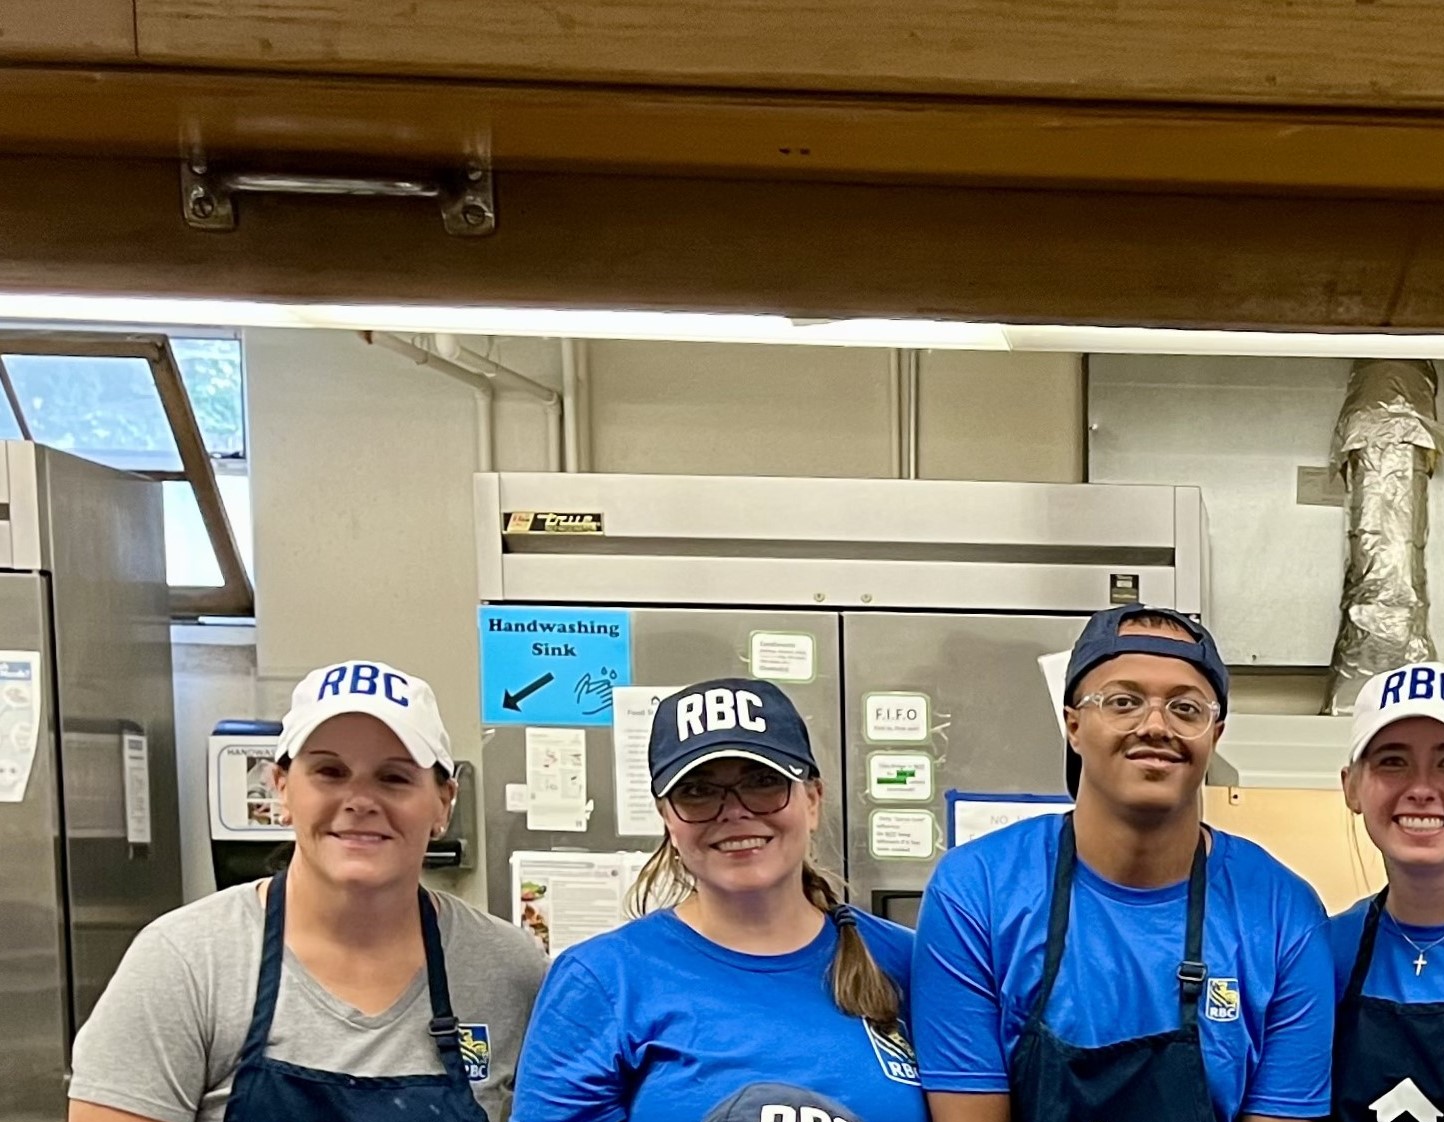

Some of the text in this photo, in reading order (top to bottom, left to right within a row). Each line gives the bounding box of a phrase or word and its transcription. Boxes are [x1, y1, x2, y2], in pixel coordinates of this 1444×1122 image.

[488, 618, 620, 637] Handwashing
[531, 642, 577, 657] Sink
[317, 664, 409, 707] RBC
[677, 688, 766, 742] RBC
[1210, 1007, 1236, 1017] RBC
[887, 1061, 920, 1079] RB
